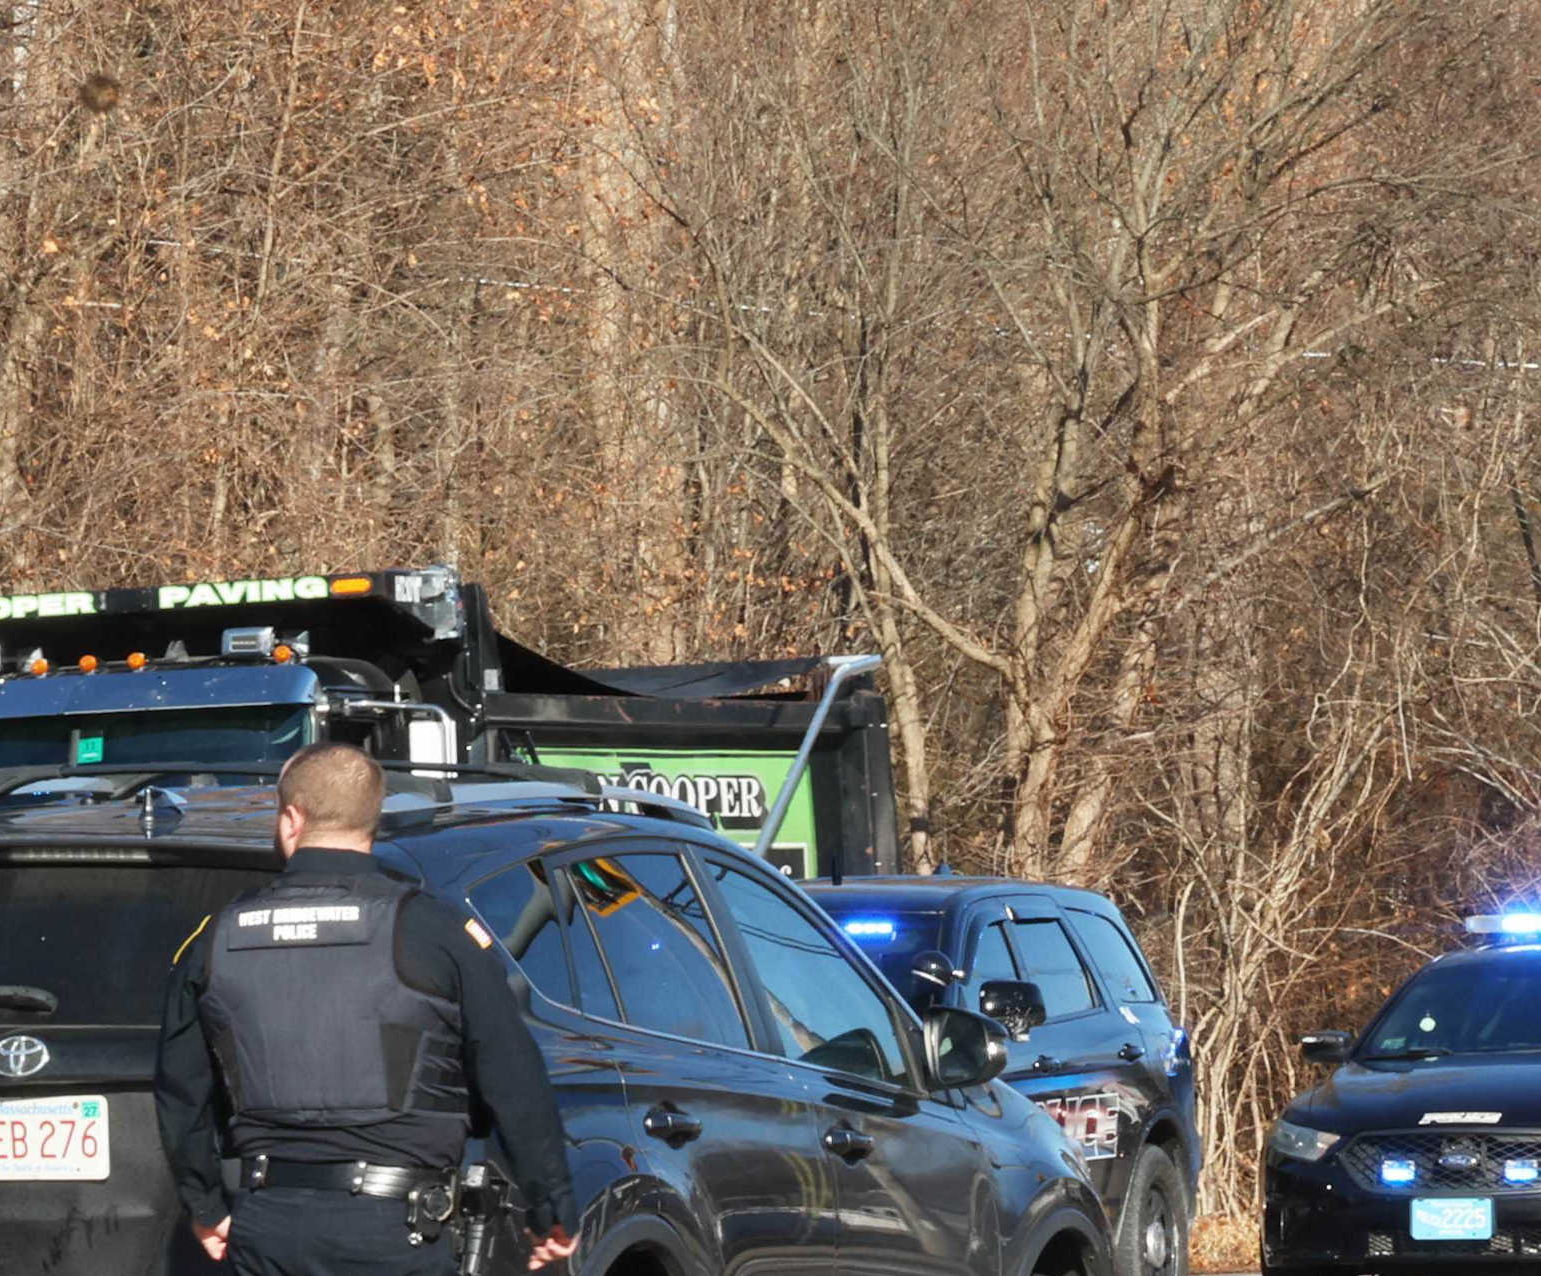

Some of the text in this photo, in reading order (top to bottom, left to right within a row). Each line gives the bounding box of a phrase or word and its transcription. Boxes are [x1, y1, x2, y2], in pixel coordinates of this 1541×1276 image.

[158, 576, 329, 610] PAVING
[239, 910, 271, 927] WEST
[273, 923, 317, 941] POLICE
[39, 1120, 98, 1159] 276
